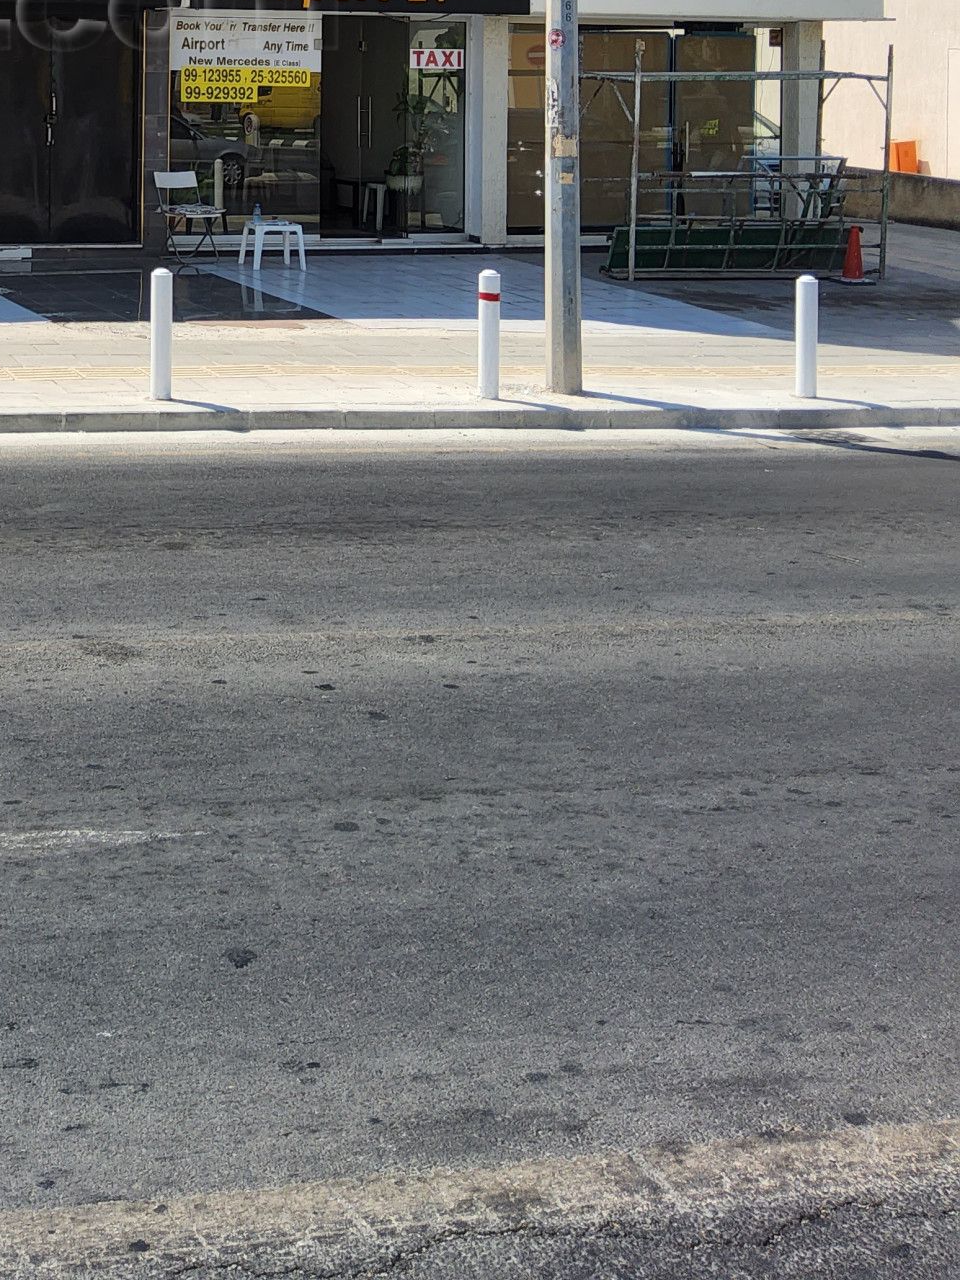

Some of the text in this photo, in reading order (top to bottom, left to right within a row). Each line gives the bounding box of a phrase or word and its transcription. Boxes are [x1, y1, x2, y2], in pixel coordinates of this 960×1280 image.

[176, 21, 201, 31] Book
[243, 22, 281, 32] Transfer
[283, 22, 306, 32] Here
[181, 37, 309, 54] Airport Any Time
[189, 56, 214, 66] New
[216, 56, 271, 66] Mercedes
[412, 50, 462, 67] TAXI
[184, 69, 307, 84] 99-123955 25-325560
[185, 86, 254, 100] 99-929392
